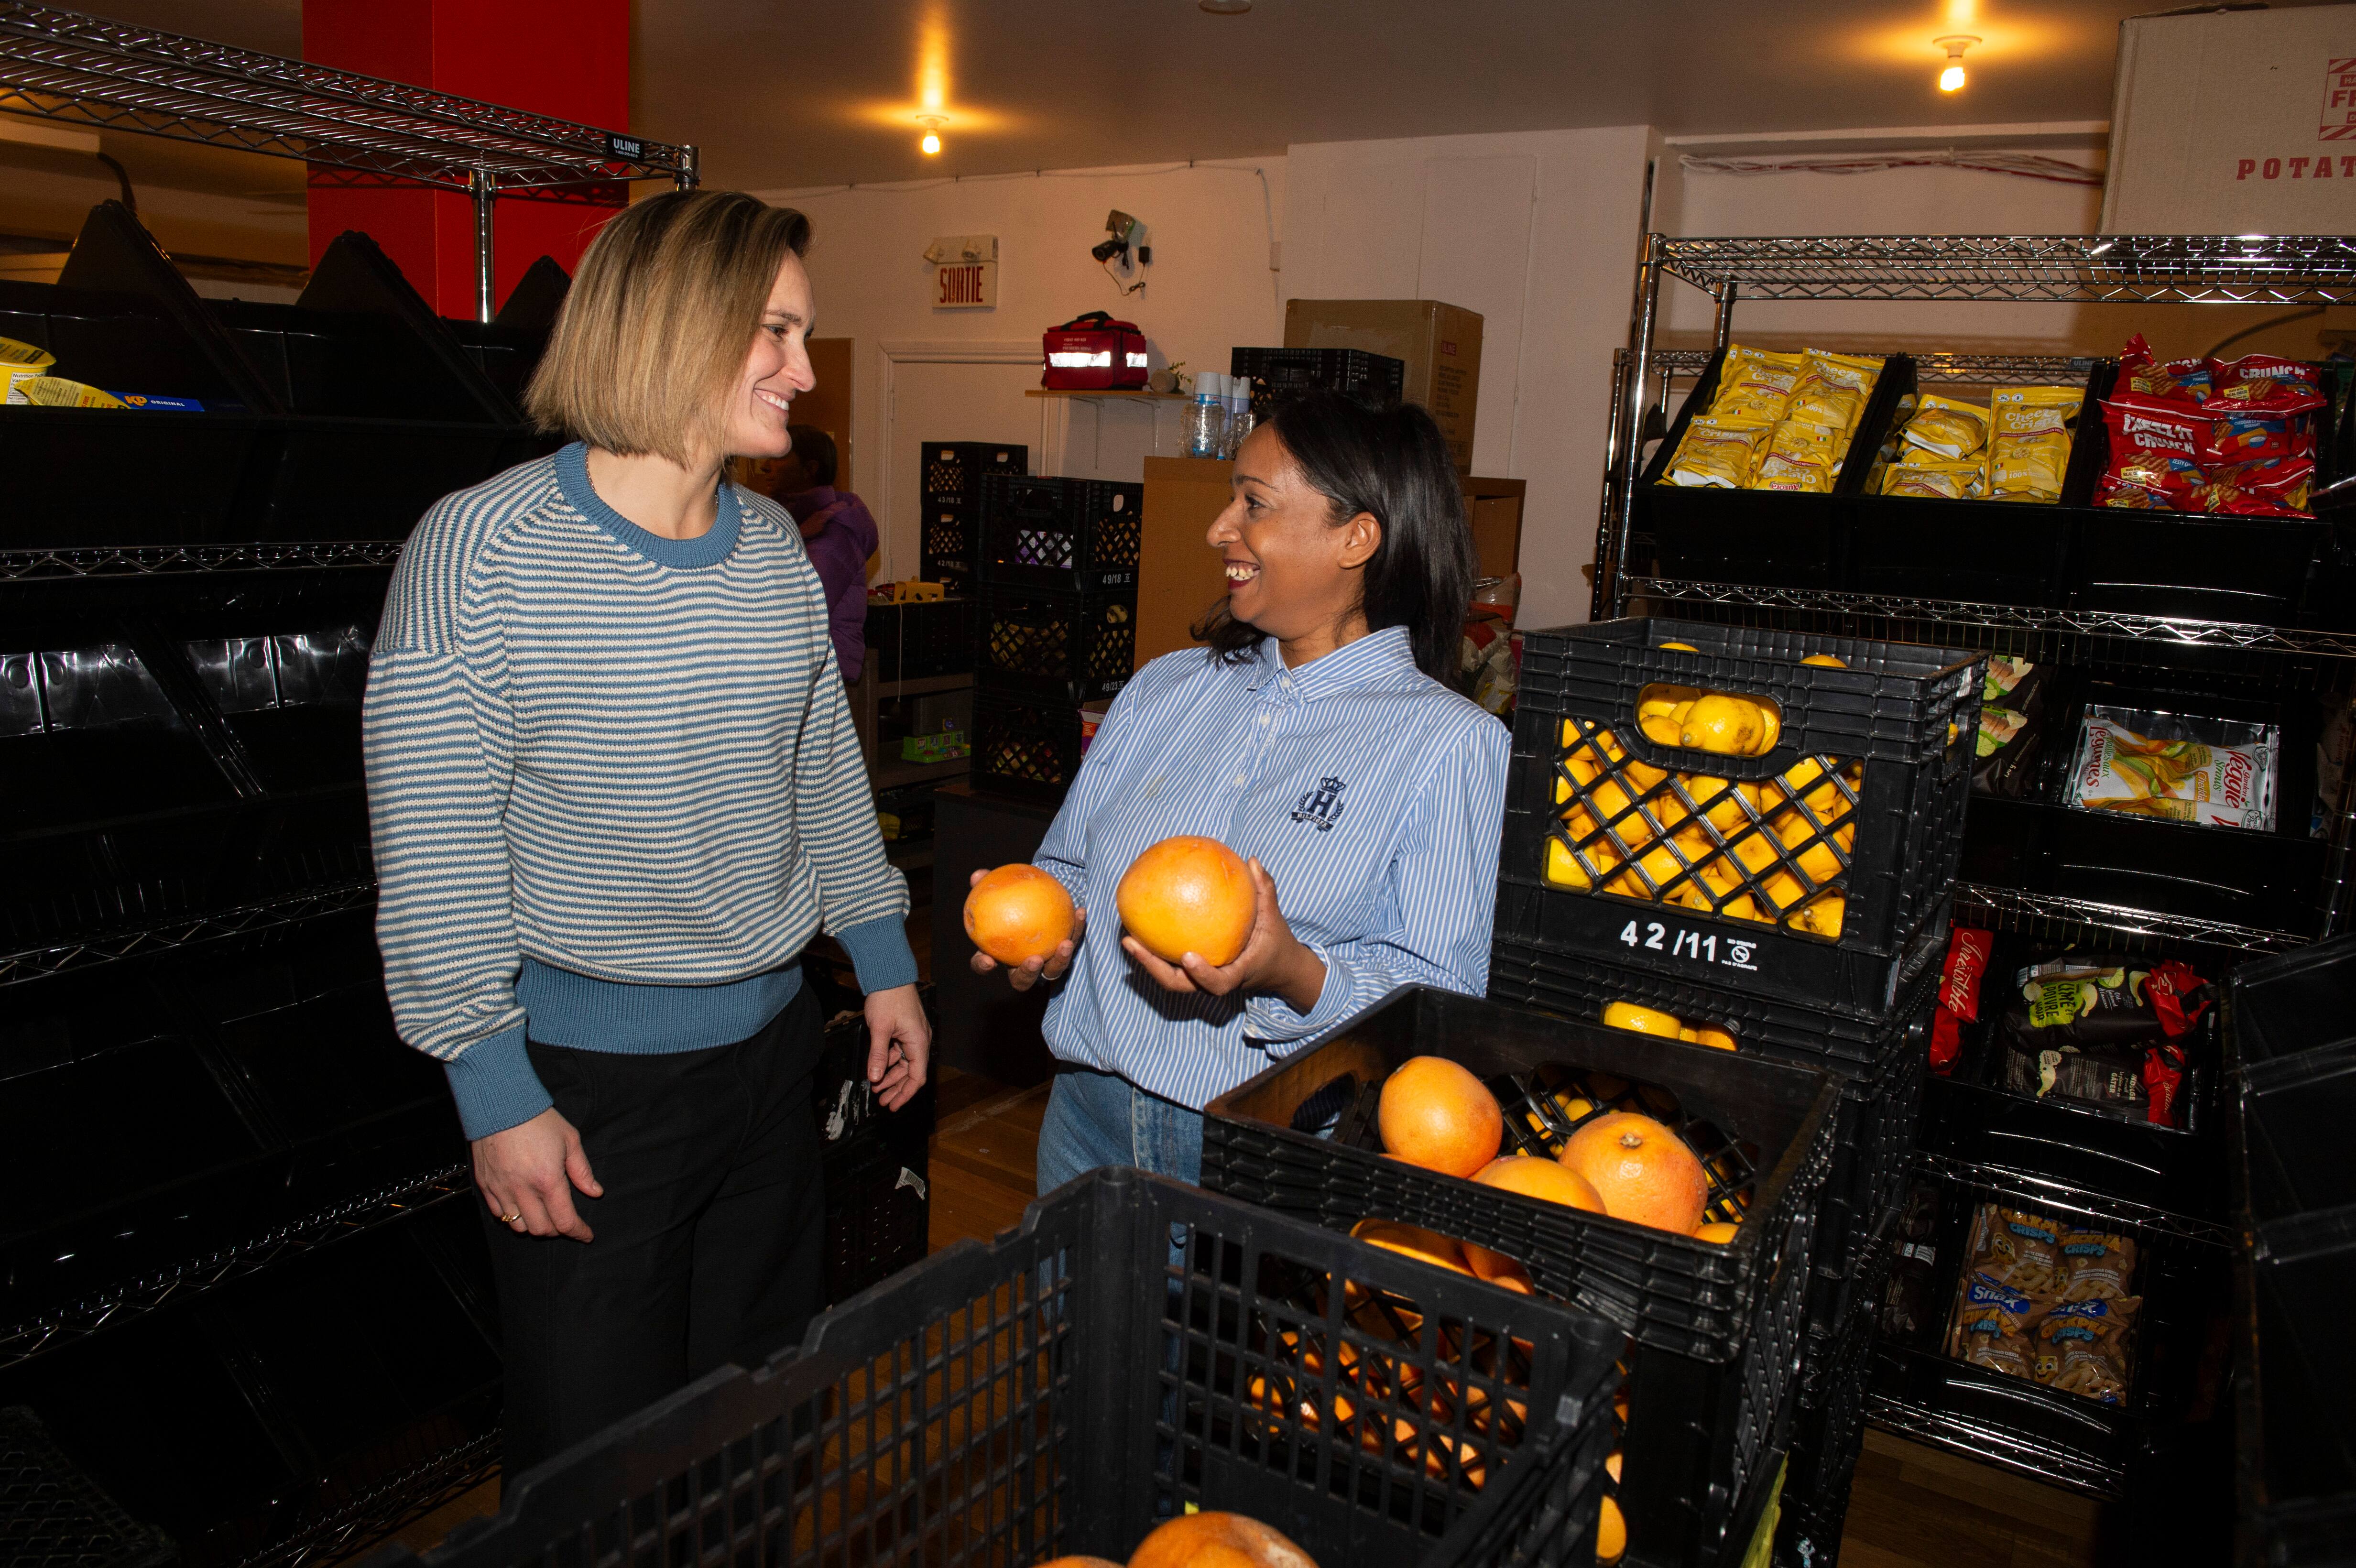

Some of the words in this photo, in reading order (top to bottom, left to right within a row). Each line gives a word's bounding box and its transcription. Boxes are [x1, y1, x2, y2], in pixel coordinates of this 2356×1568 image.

[613, 138, 640, 154] ULINE
[940, 266, 983, 303] SORTIE
[2240, 365, 2305, 379] CRUNCH
[124, 395, 148, 406] KD
[2134, 433, 2195, 455] CRUNCH
[1102, 574, 1121, 585] 49/18
[1102, 681, 1118, 692] 49/23
[2086, 726, 2113, 787] Légumes
[2213, 759, 2225, 792] Straws
[2223, 751, 2252, 809] Veggie
[1307, 790, 1337, 819] H
[1297, 813, 1329, 827] HILFIGER
[2042, 986, 2060, 1017] POIVRE
[2058, 983, 2076, 1008] LIME
[2109, 1072, 2118, 1094] GÂTER
[2129, 1073, 2138, 1101] INDULGE
[2009, 1222, 2056, 1244] CRISPS
[2063, 1243, 2107, 1258] CRISPS
[1974, 1285, 2019, 1309] Snax
